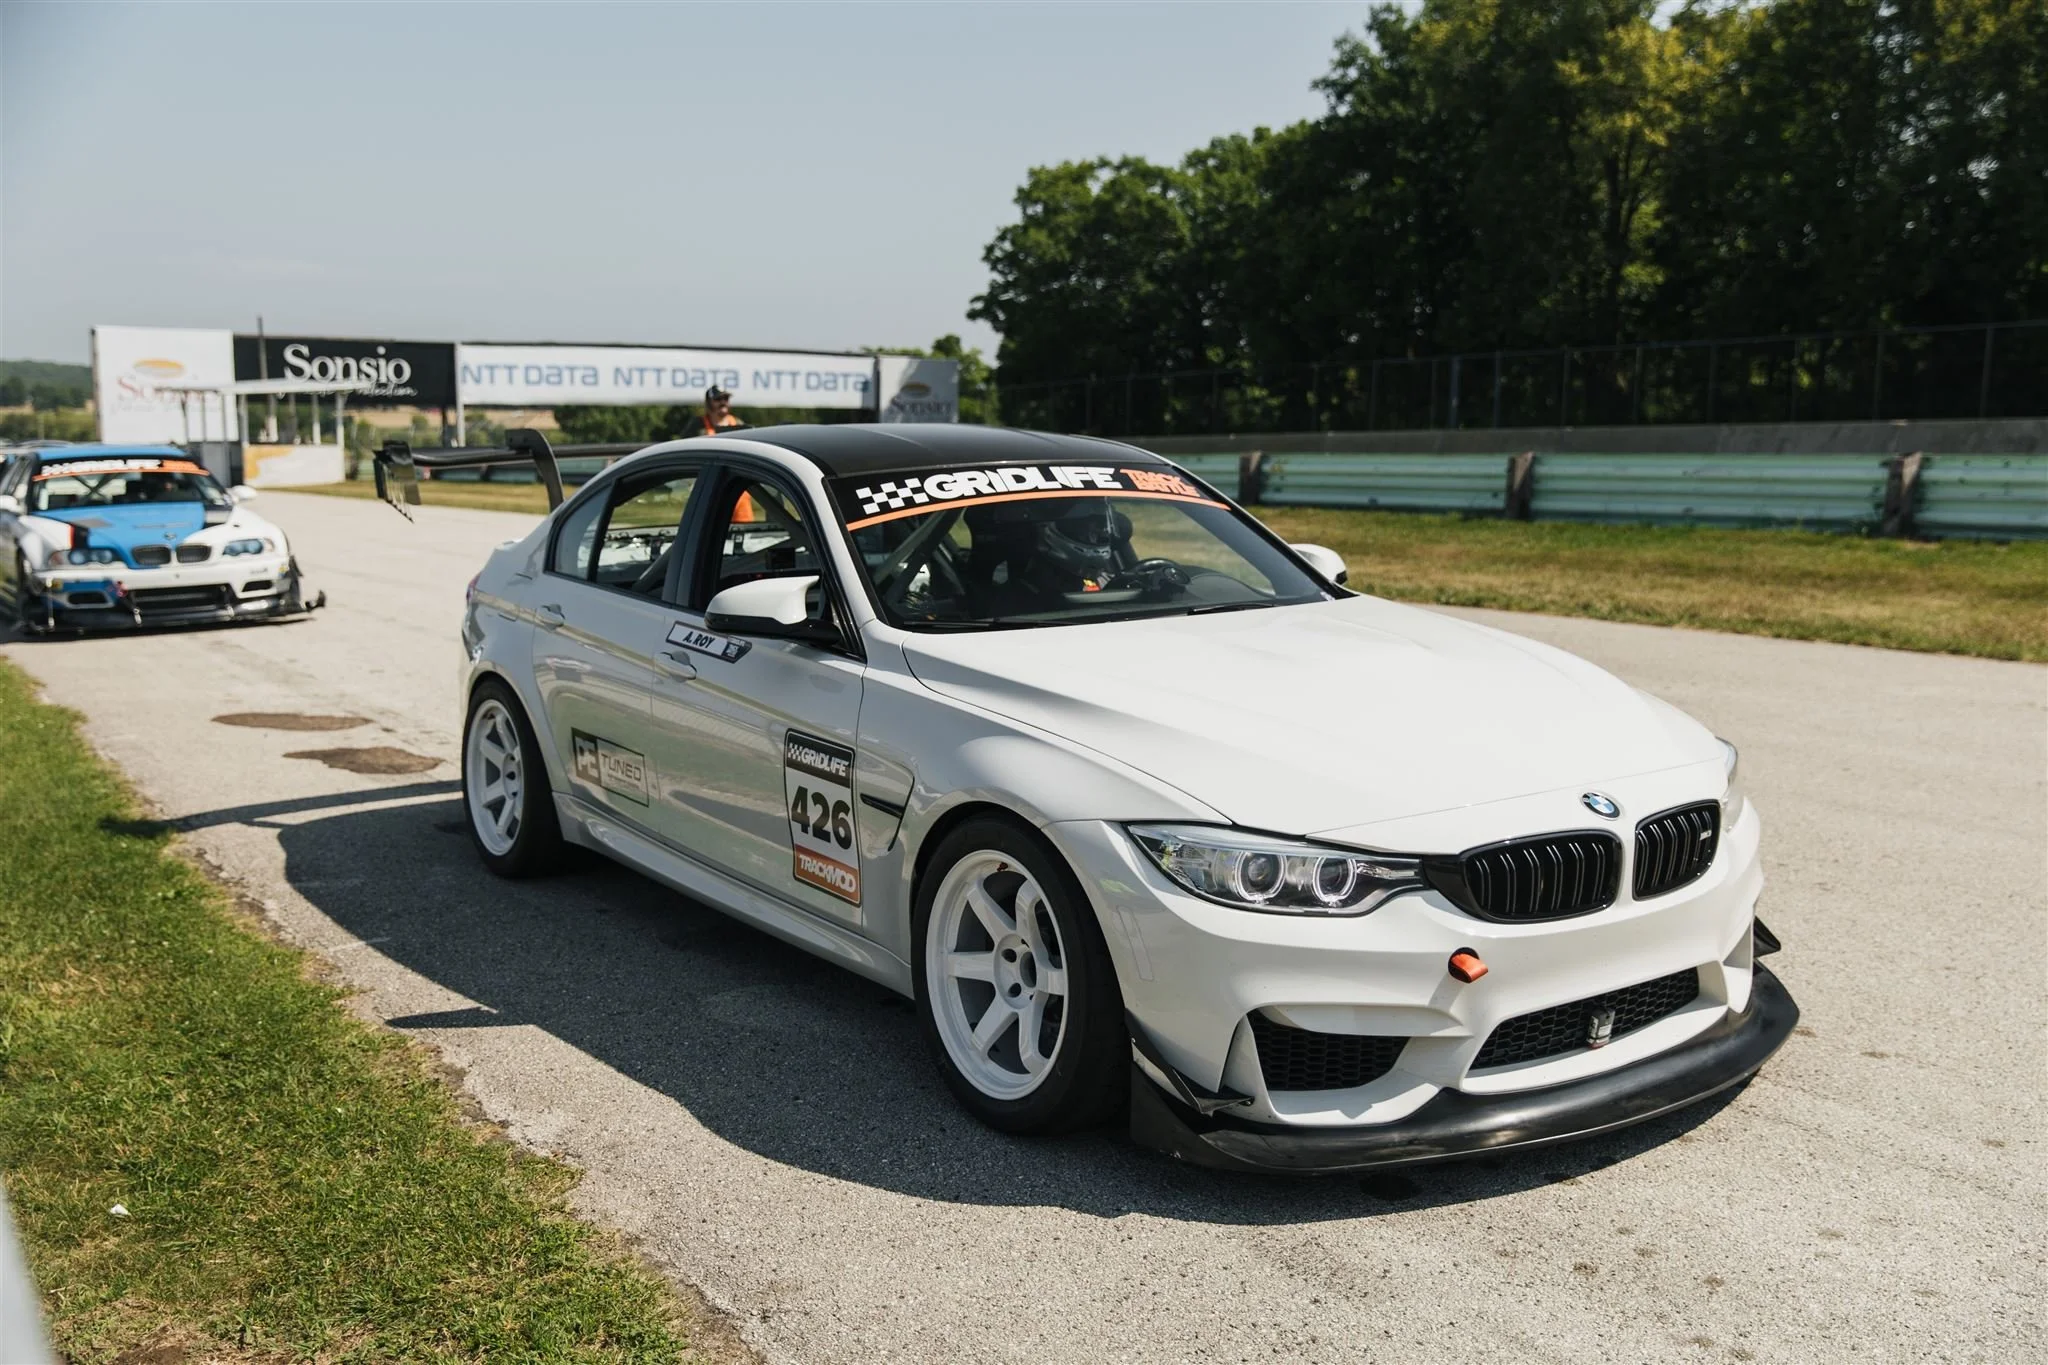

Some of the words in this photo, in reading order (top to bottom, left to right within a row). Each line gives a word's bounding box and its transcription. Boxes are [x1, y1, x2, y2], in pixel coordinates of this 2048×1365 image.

[282, 343, 412, 384] Sonsio
[461, 364, 518, 385] NTT
[613, 367, 666, 387] NTT
[752, 370, 801, 390] NTT
[923, 466, 1123, 499] GRIDLIFE
[1120, 469, 1183, 484] TRACK
[692, 633, 715, 649] ROY
[601, 752, 642, 782] TUNED
[801, 747, 850, 777] GRIDLIFE
[791, 785, 853, 850] 426
